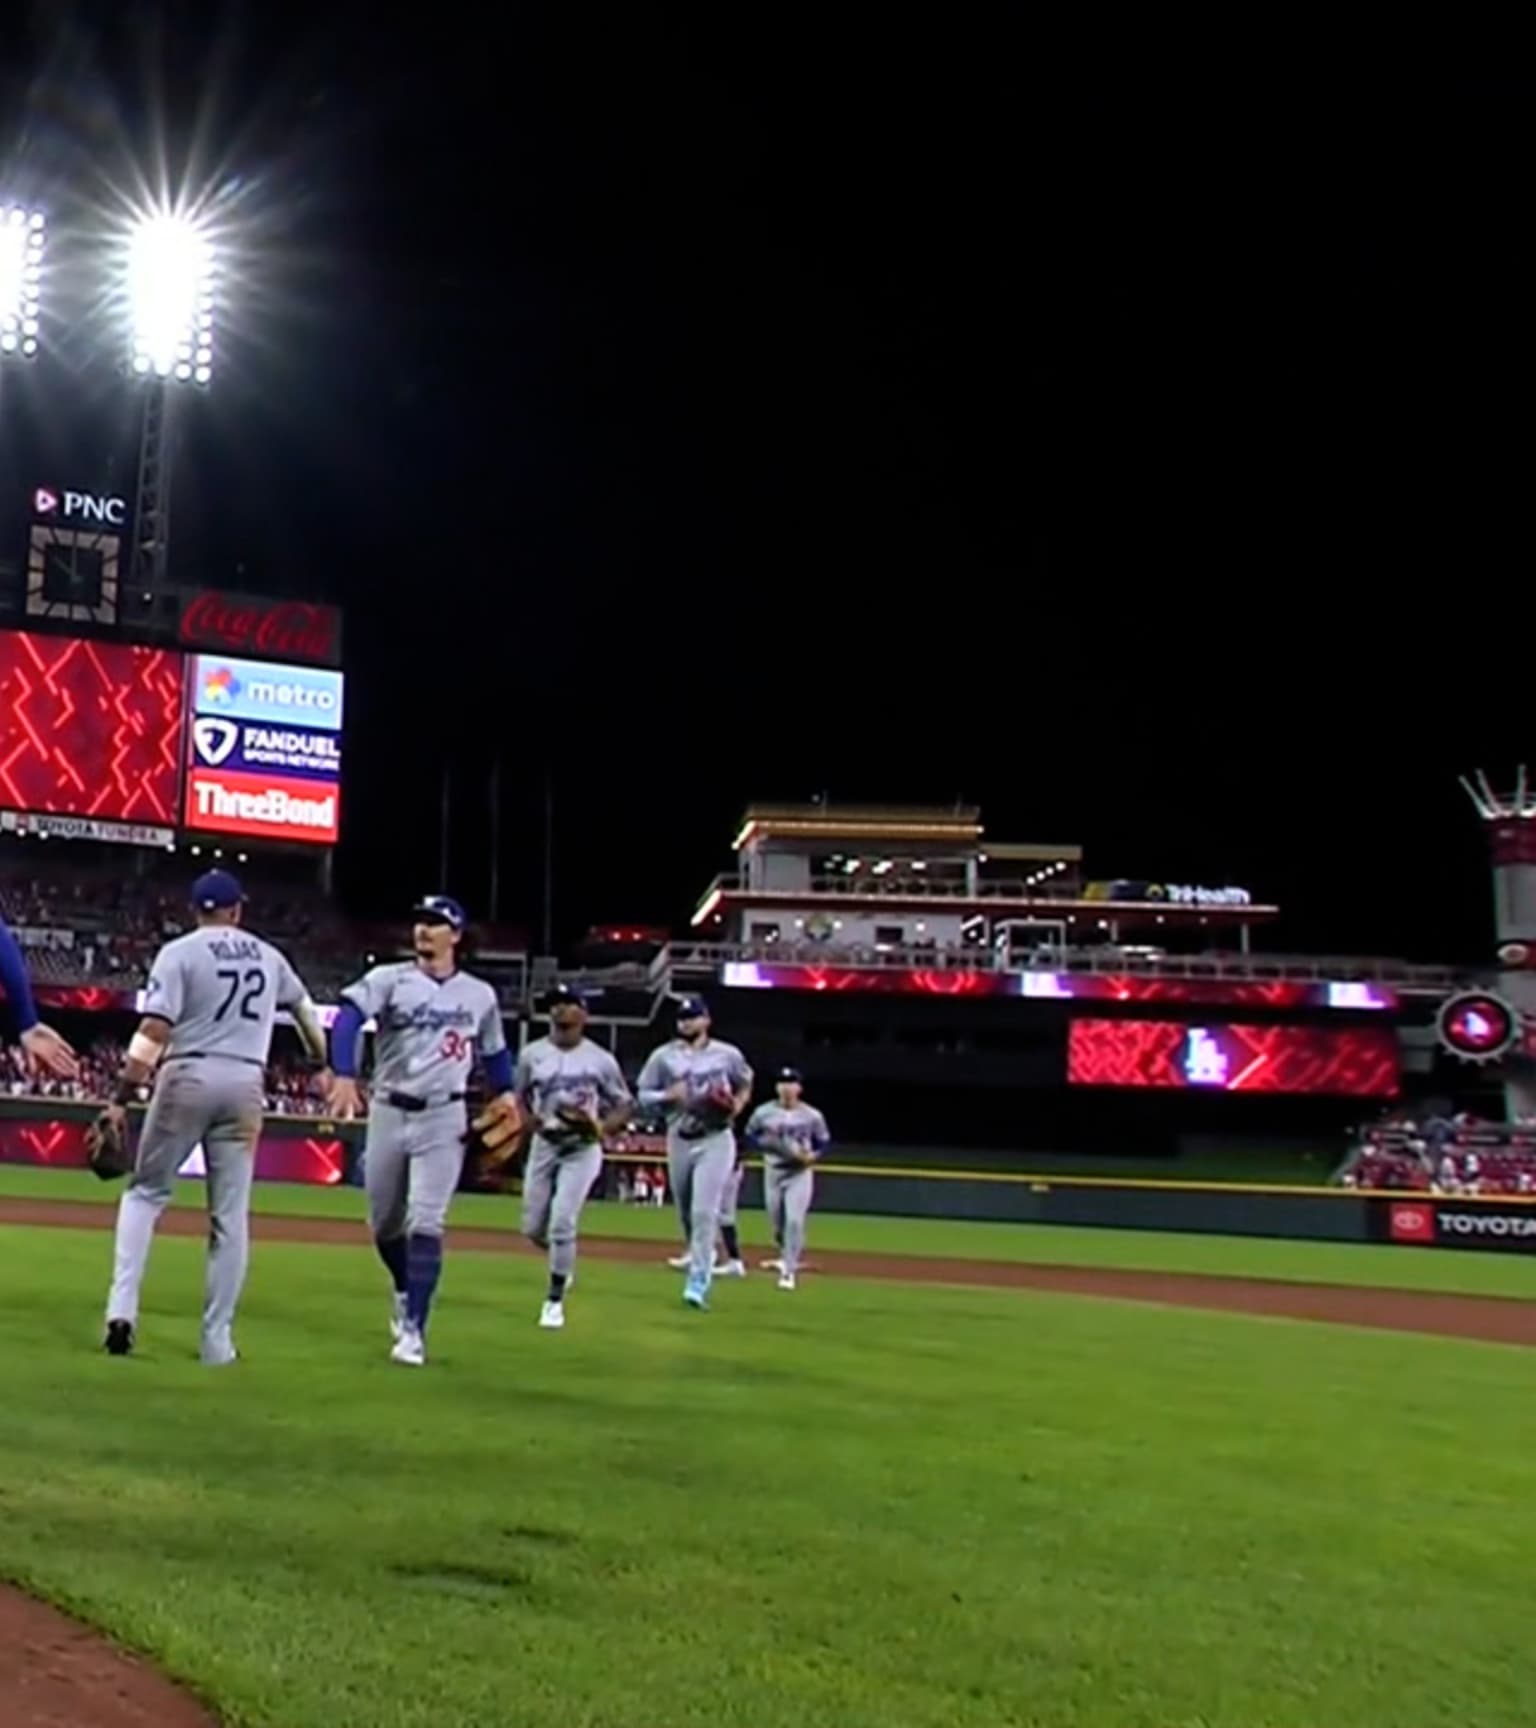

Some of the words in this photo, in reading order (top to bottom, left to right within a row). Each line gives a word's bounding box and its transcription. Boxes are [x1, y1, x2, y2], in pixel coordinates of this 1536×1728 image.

[63, 491, 126, 524] PNC
[248, 680, 334, 709] metro
[244, 727, 340, 758] FANDUEL
[194, 781, 334, 828] ThreeBond
[207, 940, 262, 961] ROJAS
[214, 968, 267, 1021] 72
[1437, 1213, 1536, 1237] TOYOTA
